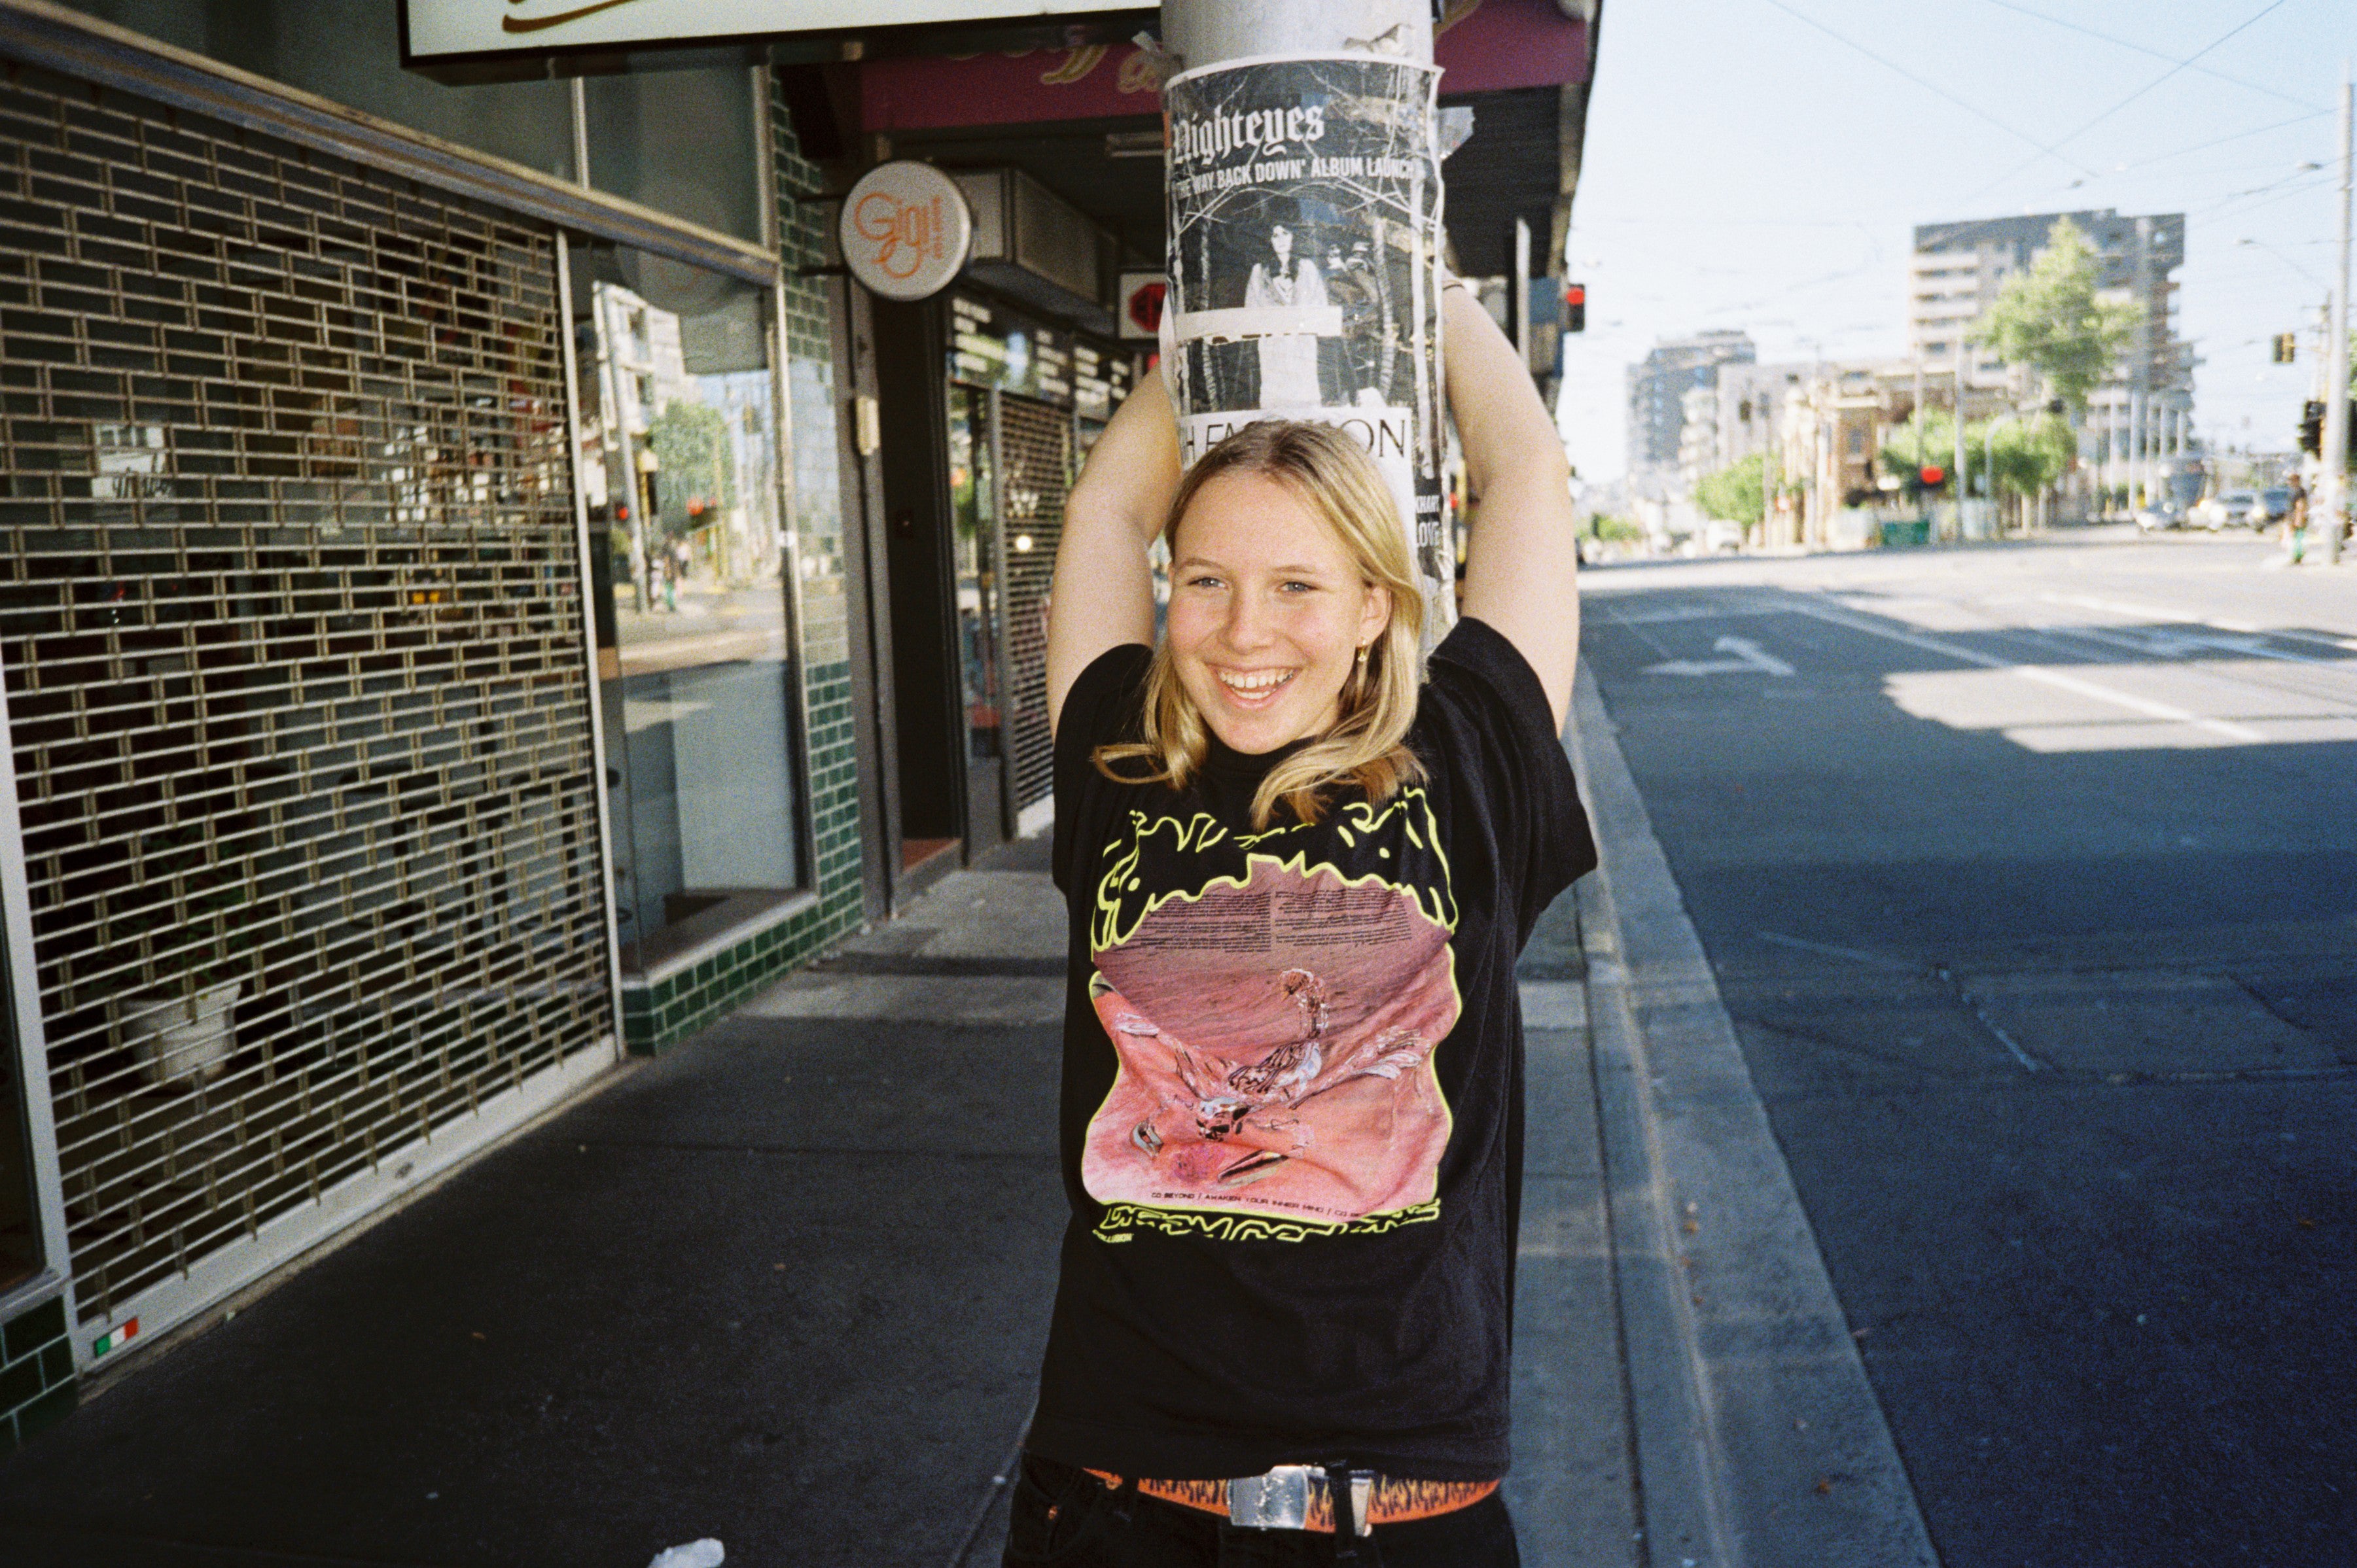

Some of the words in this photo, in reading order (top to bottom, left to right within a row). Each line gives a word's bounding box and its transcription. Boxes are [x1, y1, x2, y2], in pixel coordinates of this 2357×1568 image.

[1192, 171, 1214, 195] WAY
[1216, 164, 1252, 189] BACK
[1311, 157, 1364, 178] ALBUM
[1366, 157, 1415, 179] LAUNCH
[1205, 1193, 1242, 1202] AWAKEN
[1271, 1200, 1300, 1209] INNER
[1302, 1204, 1324, 1213] MIND
